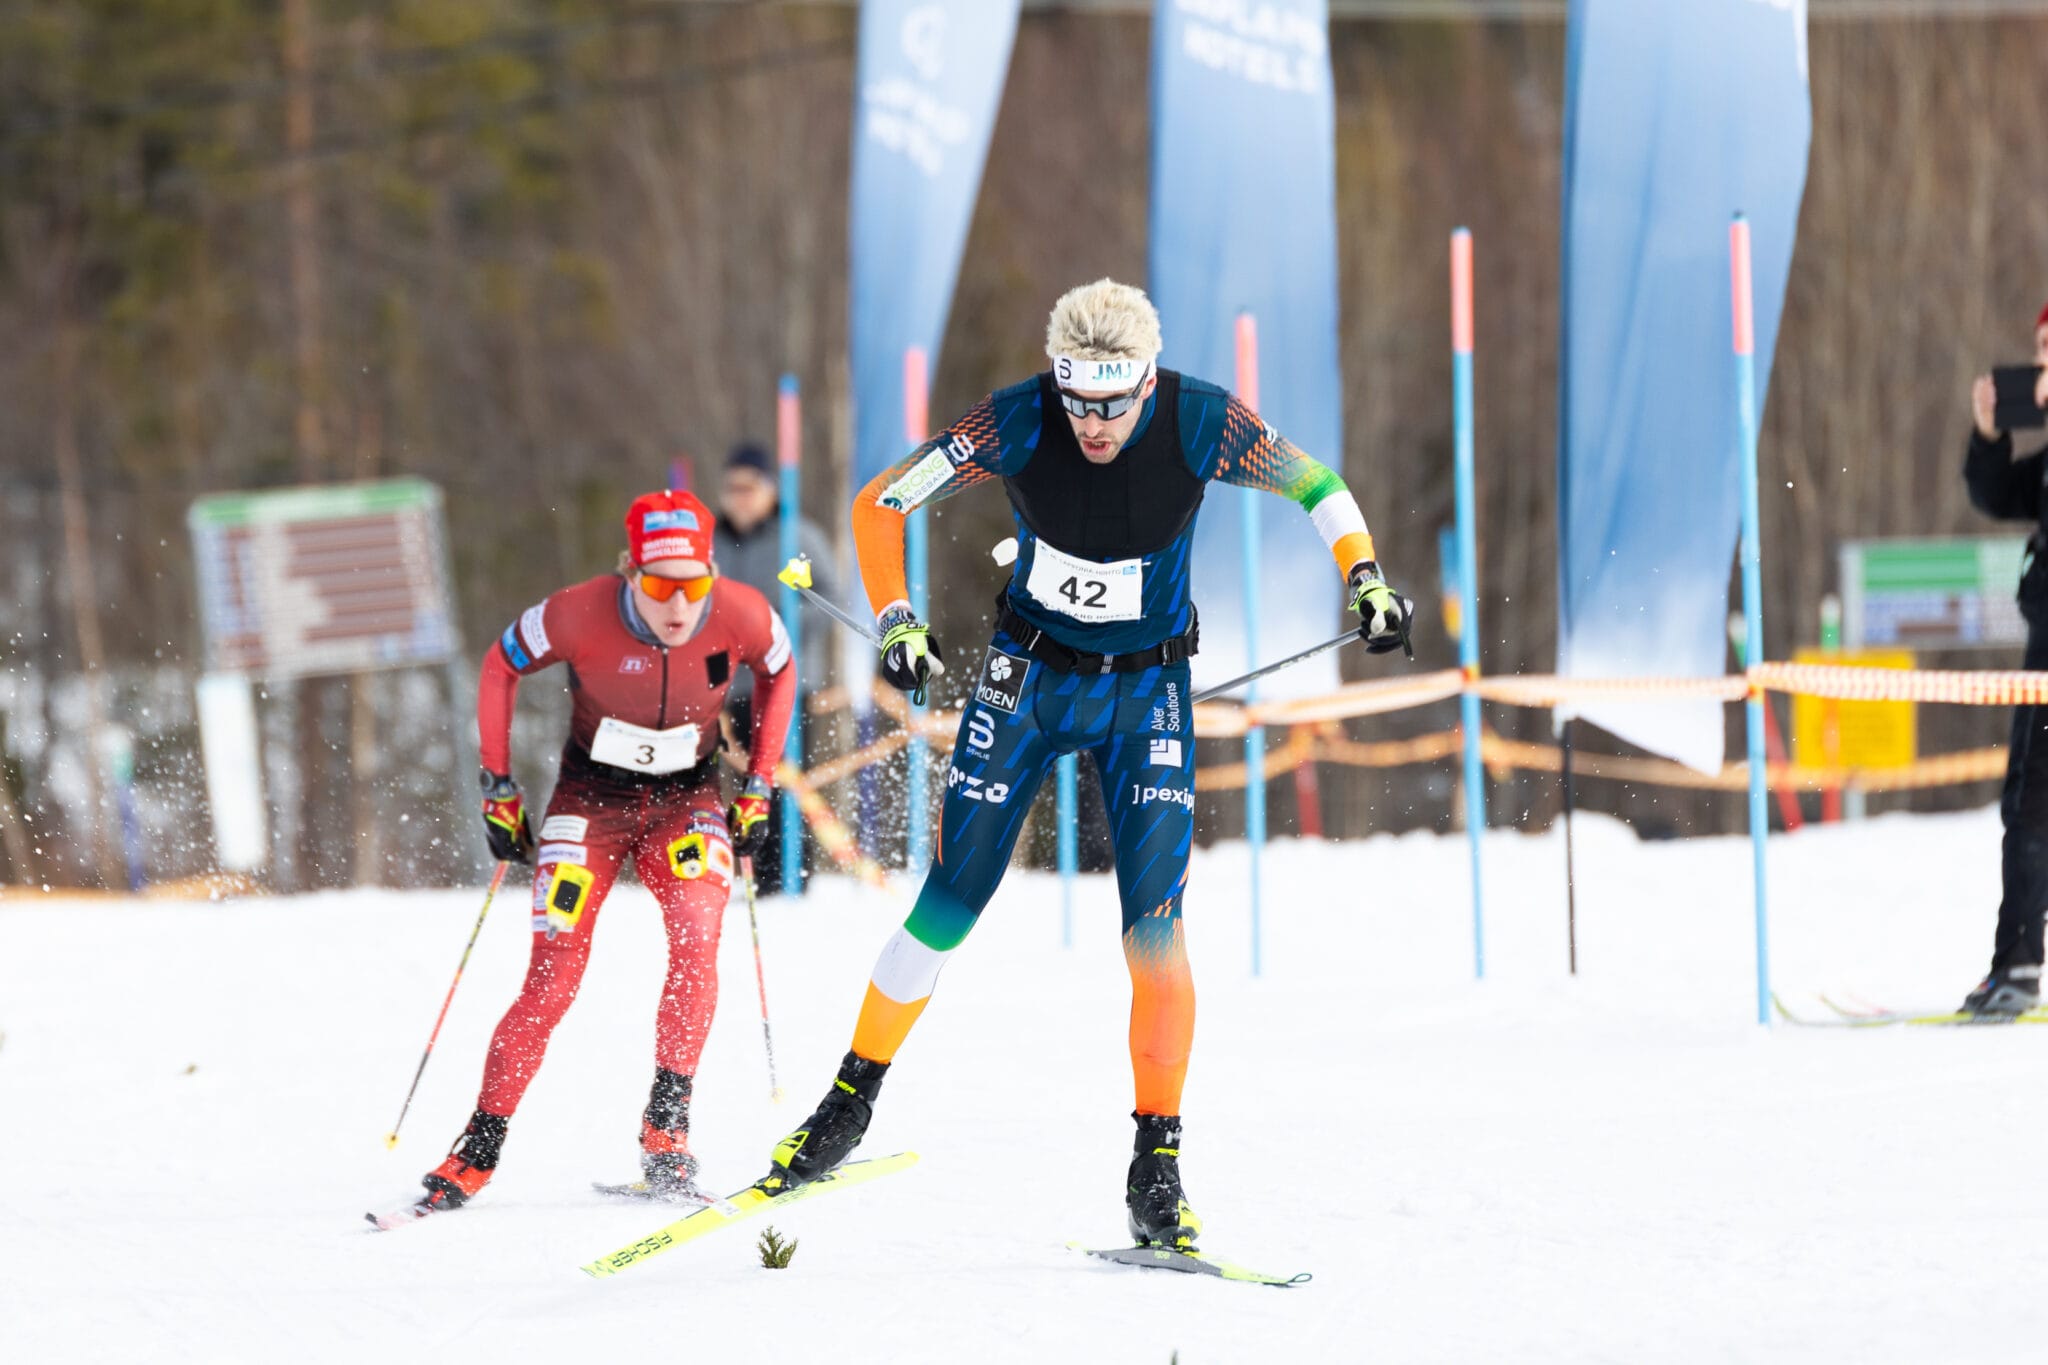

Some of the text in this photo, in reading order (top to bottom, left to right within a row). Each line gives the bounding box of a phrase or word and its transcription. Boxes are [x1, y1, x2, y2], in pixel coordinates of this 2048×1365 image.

[1059, 575, 1107, 608] 42
[977, 685, 1016, 710] MOEN
[1166, 682, 1180, 732] Solutions
[1151, 706, 1166, 731] Aker
[635, 744, 655, 766] 3
[608, 1231, 673, 1267] FISCHER
